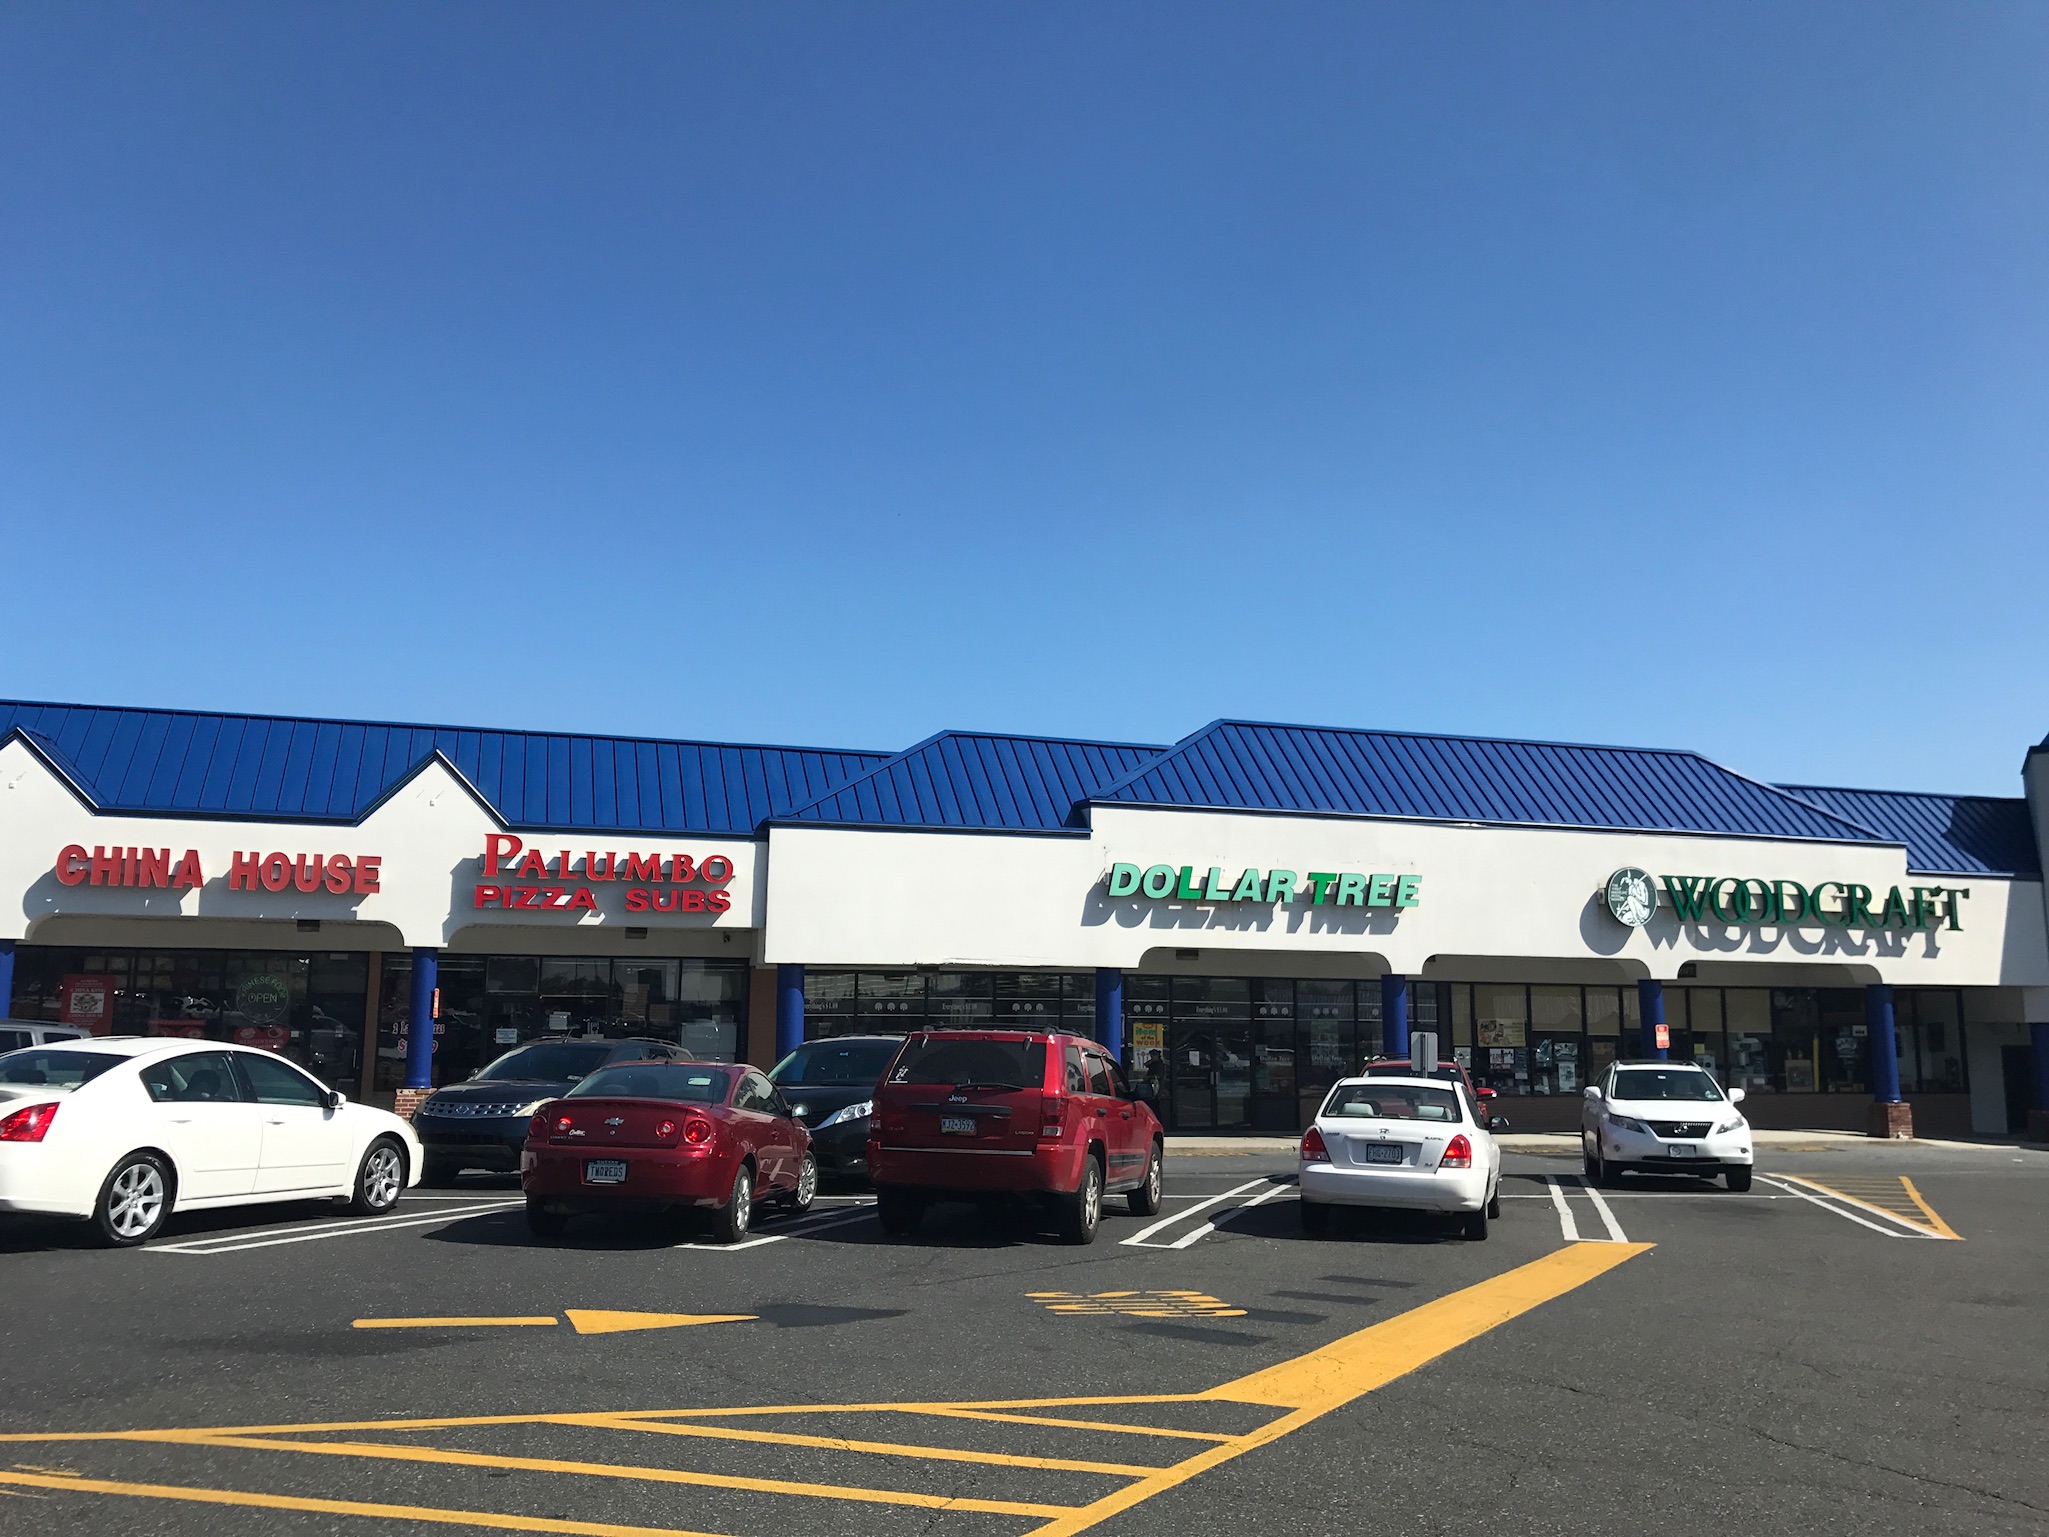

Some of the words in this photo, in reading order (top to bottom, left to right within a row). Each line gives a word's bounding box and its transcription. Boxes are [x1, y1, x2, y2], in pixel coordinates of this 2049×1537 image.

[56, 844, 204, 888] CHINA
[229, 851, 382, 895] HOUSE
[1108, 863, 1298, 904] DOLLAR
[1308, 872, 1422, 908] TREE
[474, 884, 597, 911] PIZZA
[625, 888, 731, 914] SUBS
[1658, 875, 1970, 932] WOODCRAFT
[248, 993, 278, 1004] OPEN
[948, 1094, 968, 1103] Jeep
